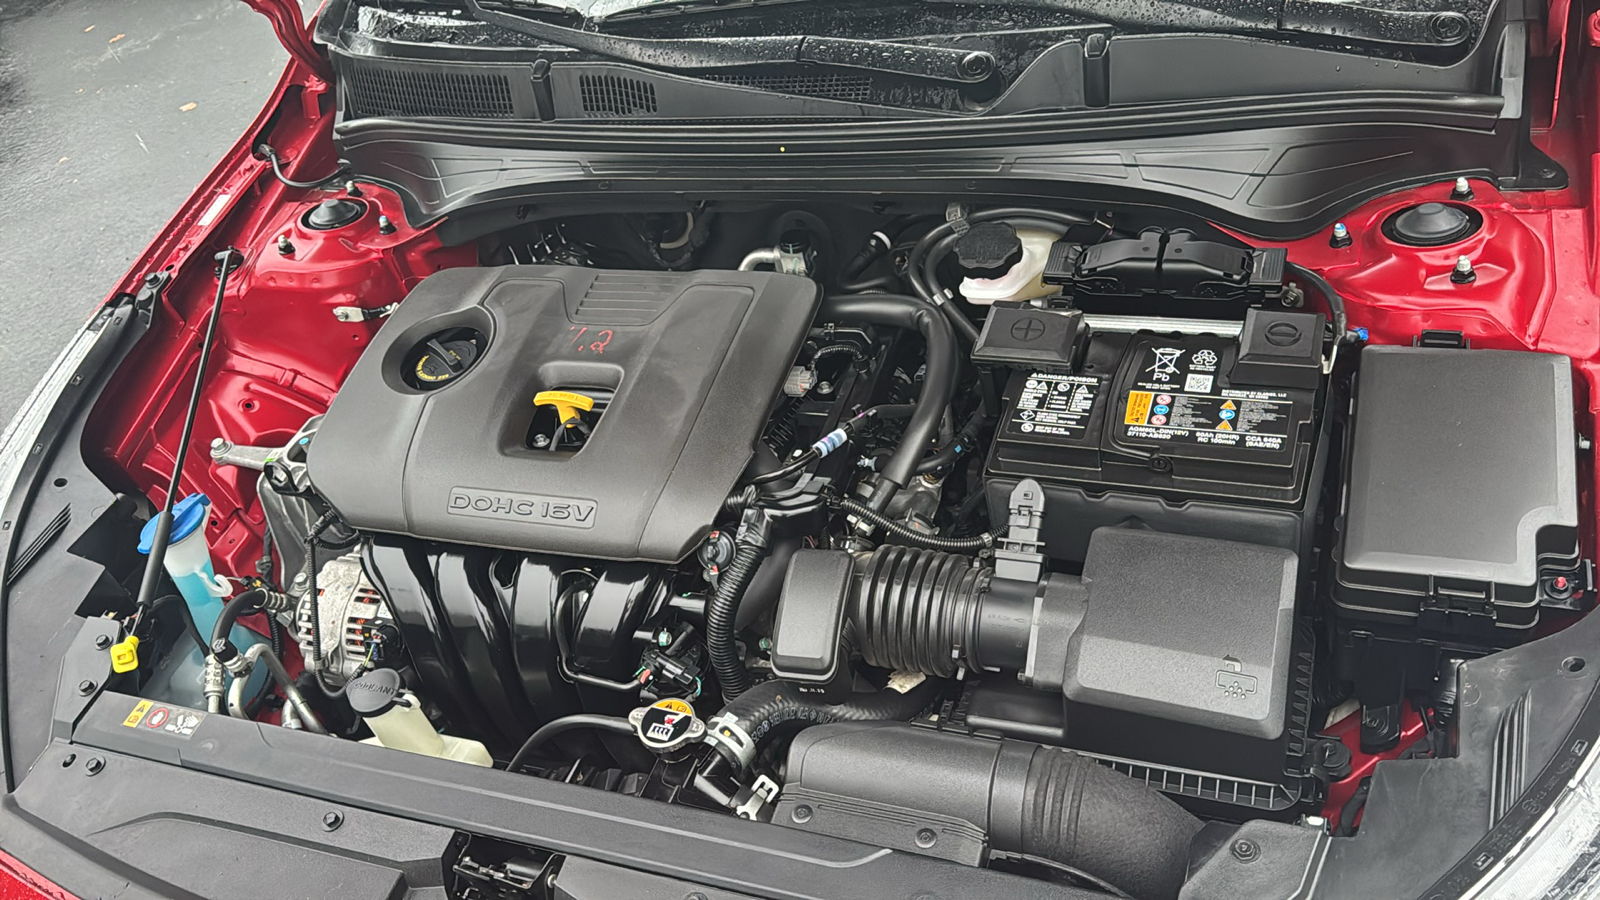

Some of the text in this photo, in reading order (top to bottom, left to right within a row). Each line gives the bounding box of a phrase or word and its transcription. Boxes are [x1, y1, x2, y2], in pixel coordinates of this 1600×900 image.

[1037, 373, 1098, 383] DANGER/POISON
[1153, 372, 1170, 382] Pb
[1215, 433, 1240, 441] (20HR)
[1245, 435, 1262, 443] CCA
[450, 493, 594, 522] DOHC 16V
